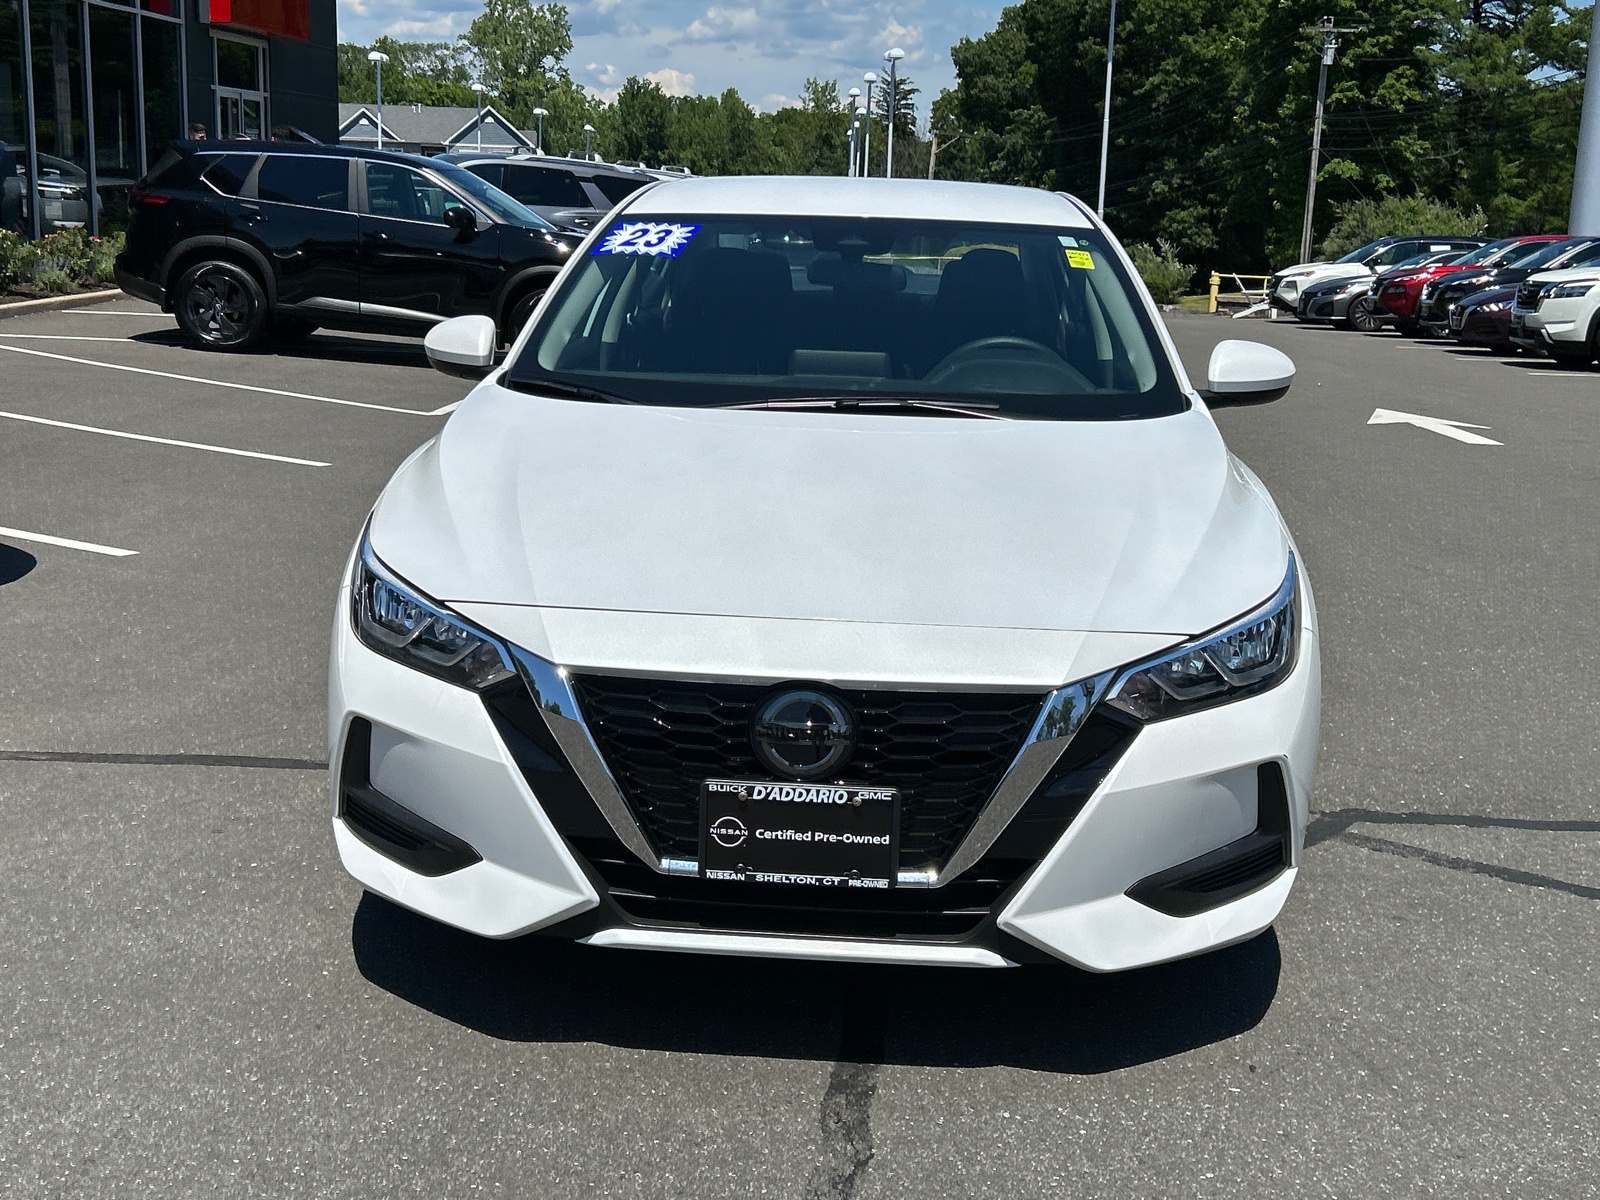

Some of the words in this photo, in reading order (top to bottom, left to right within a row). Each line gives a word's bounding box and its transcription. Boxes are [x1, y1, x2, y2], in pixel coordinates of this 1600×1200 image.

[617, 228, 673, 248] 23
[708, 784, 747, 793] BUICK
[752, 786, 848, 804] D'ADDARIO
[858, 791, 892, 800] GMC
[709, 827, 748, 836] NISSAN
[755, 828, 812, 842] Certified
[814, 831, 890, 845] Pre-Owned
[706, 872, 746, 881] NISSAN
[755, 874, 819, 886] SHELTON,
[823, 877, 841, 886] CT
[848, 879, 888, 888] PRE-OWNED
